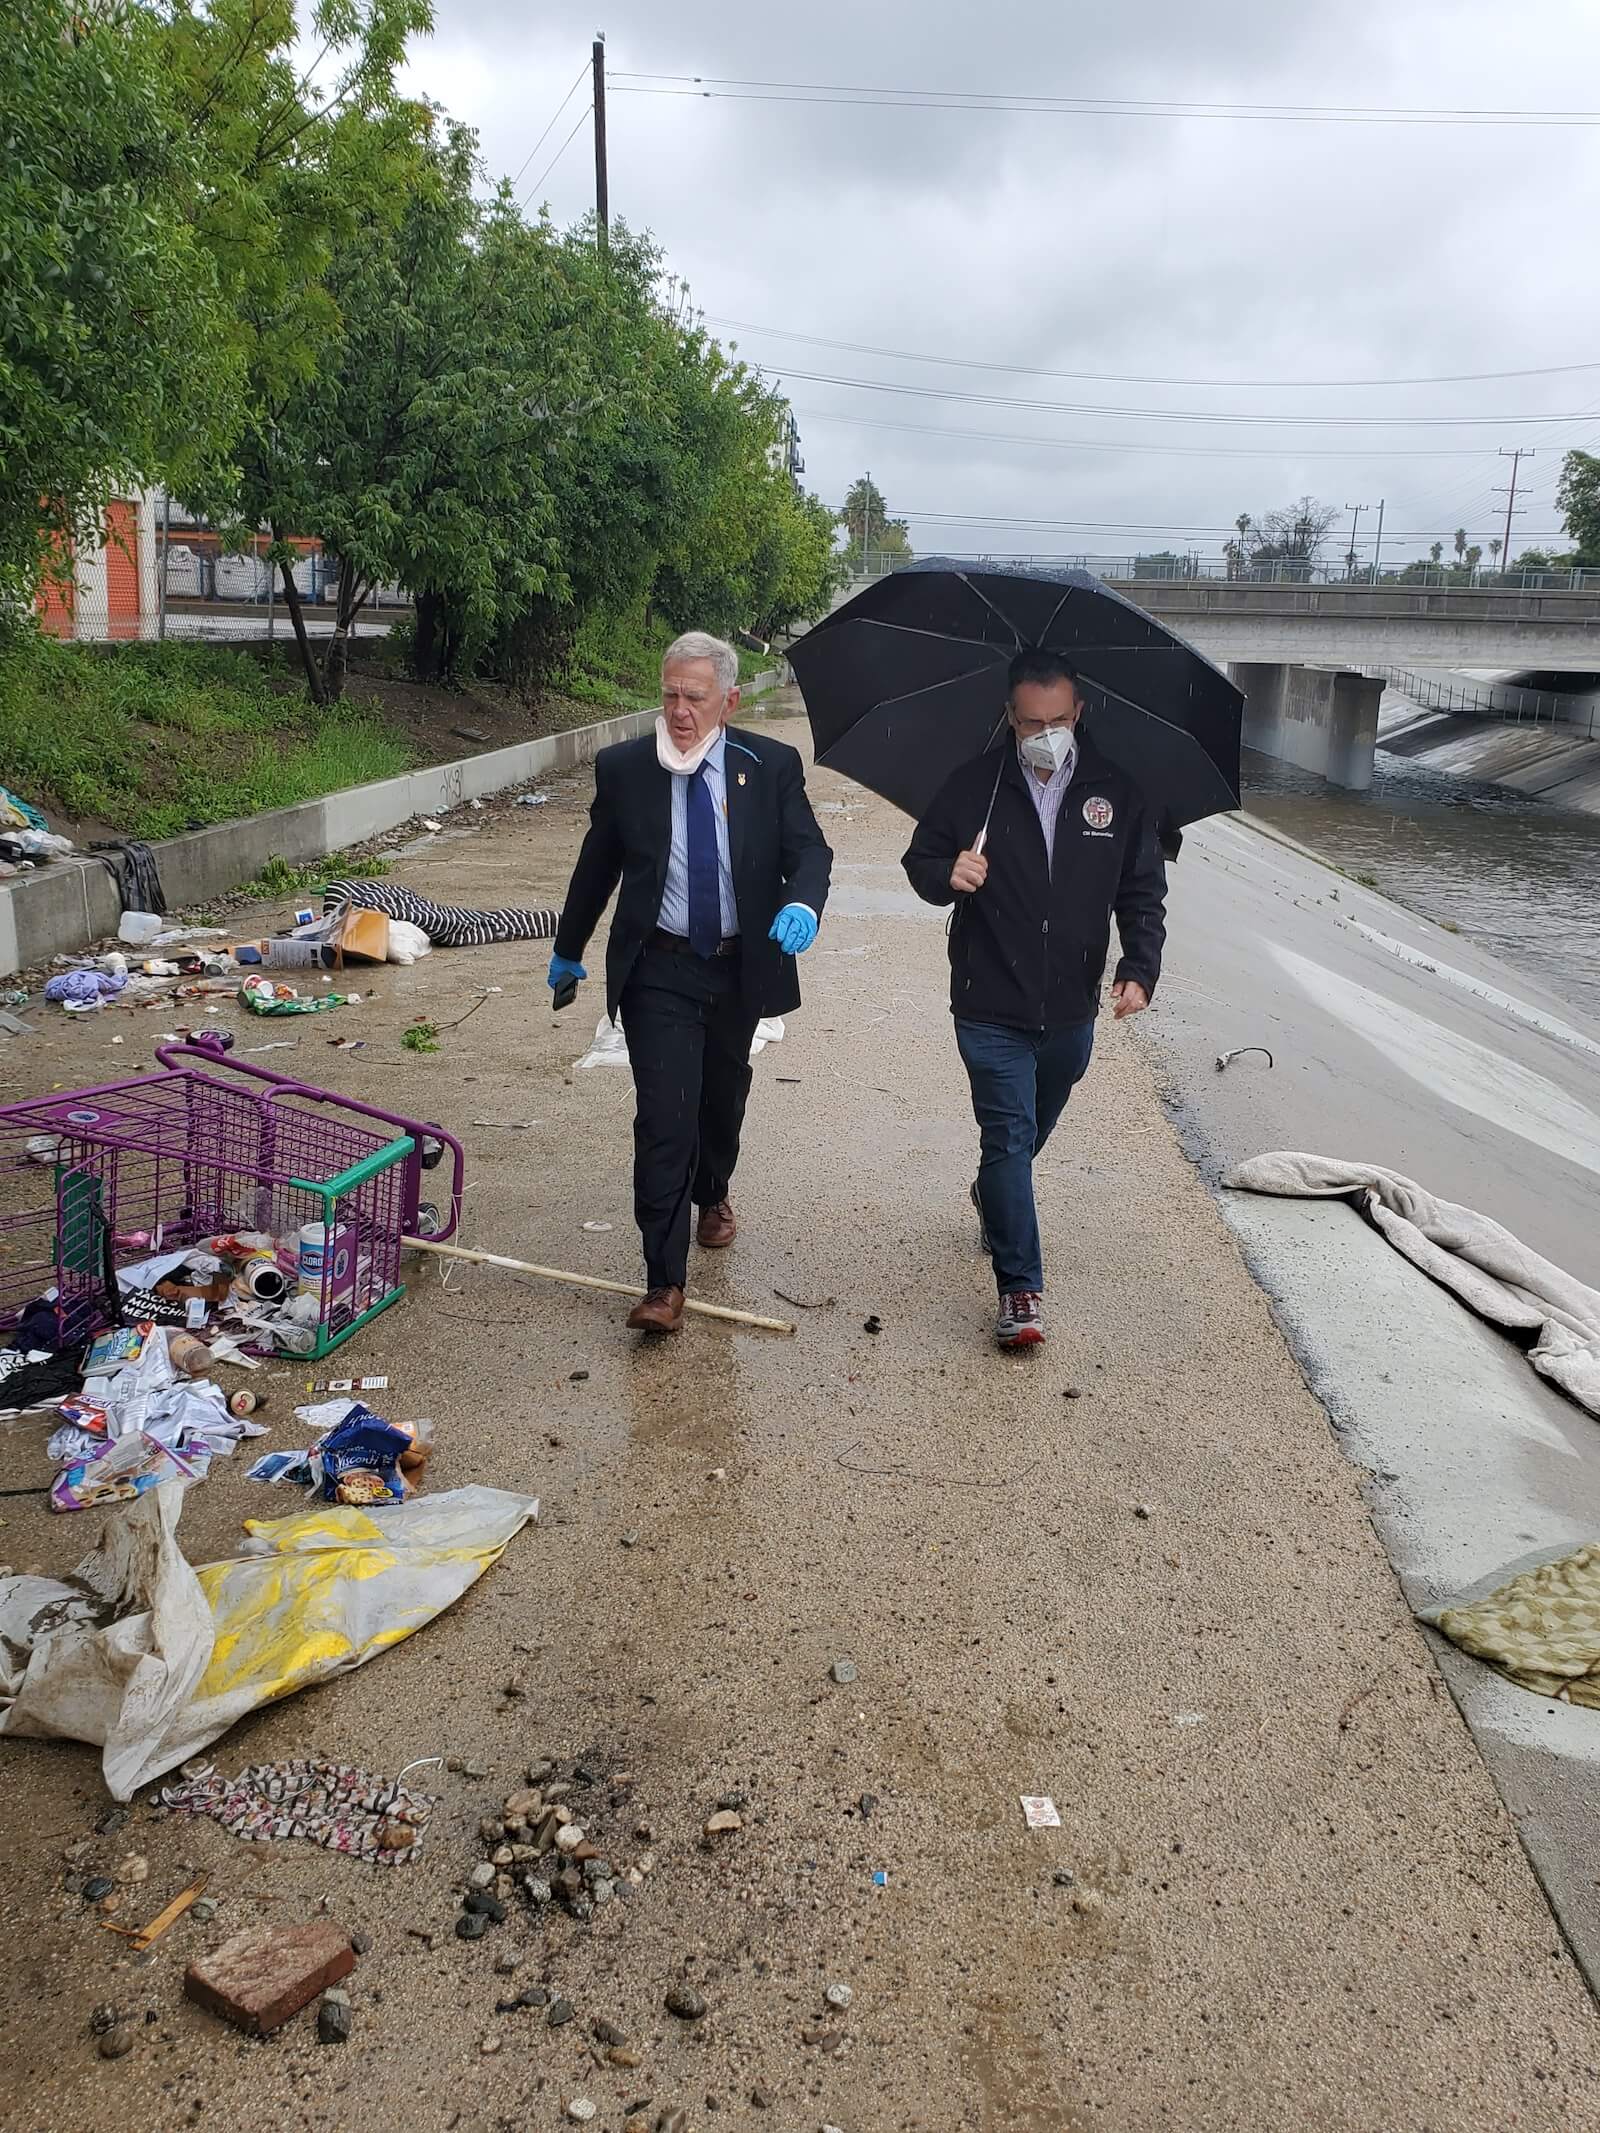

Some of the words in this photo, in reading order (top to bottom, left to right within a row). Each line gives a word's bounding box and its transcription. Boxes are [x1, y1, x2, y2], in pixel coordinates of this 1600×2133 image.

[302, 1254, 324, 1267] CLORO
[135, 1290, 178, 1306] JACK
[121, 1304, 159, 1321] MEAL
